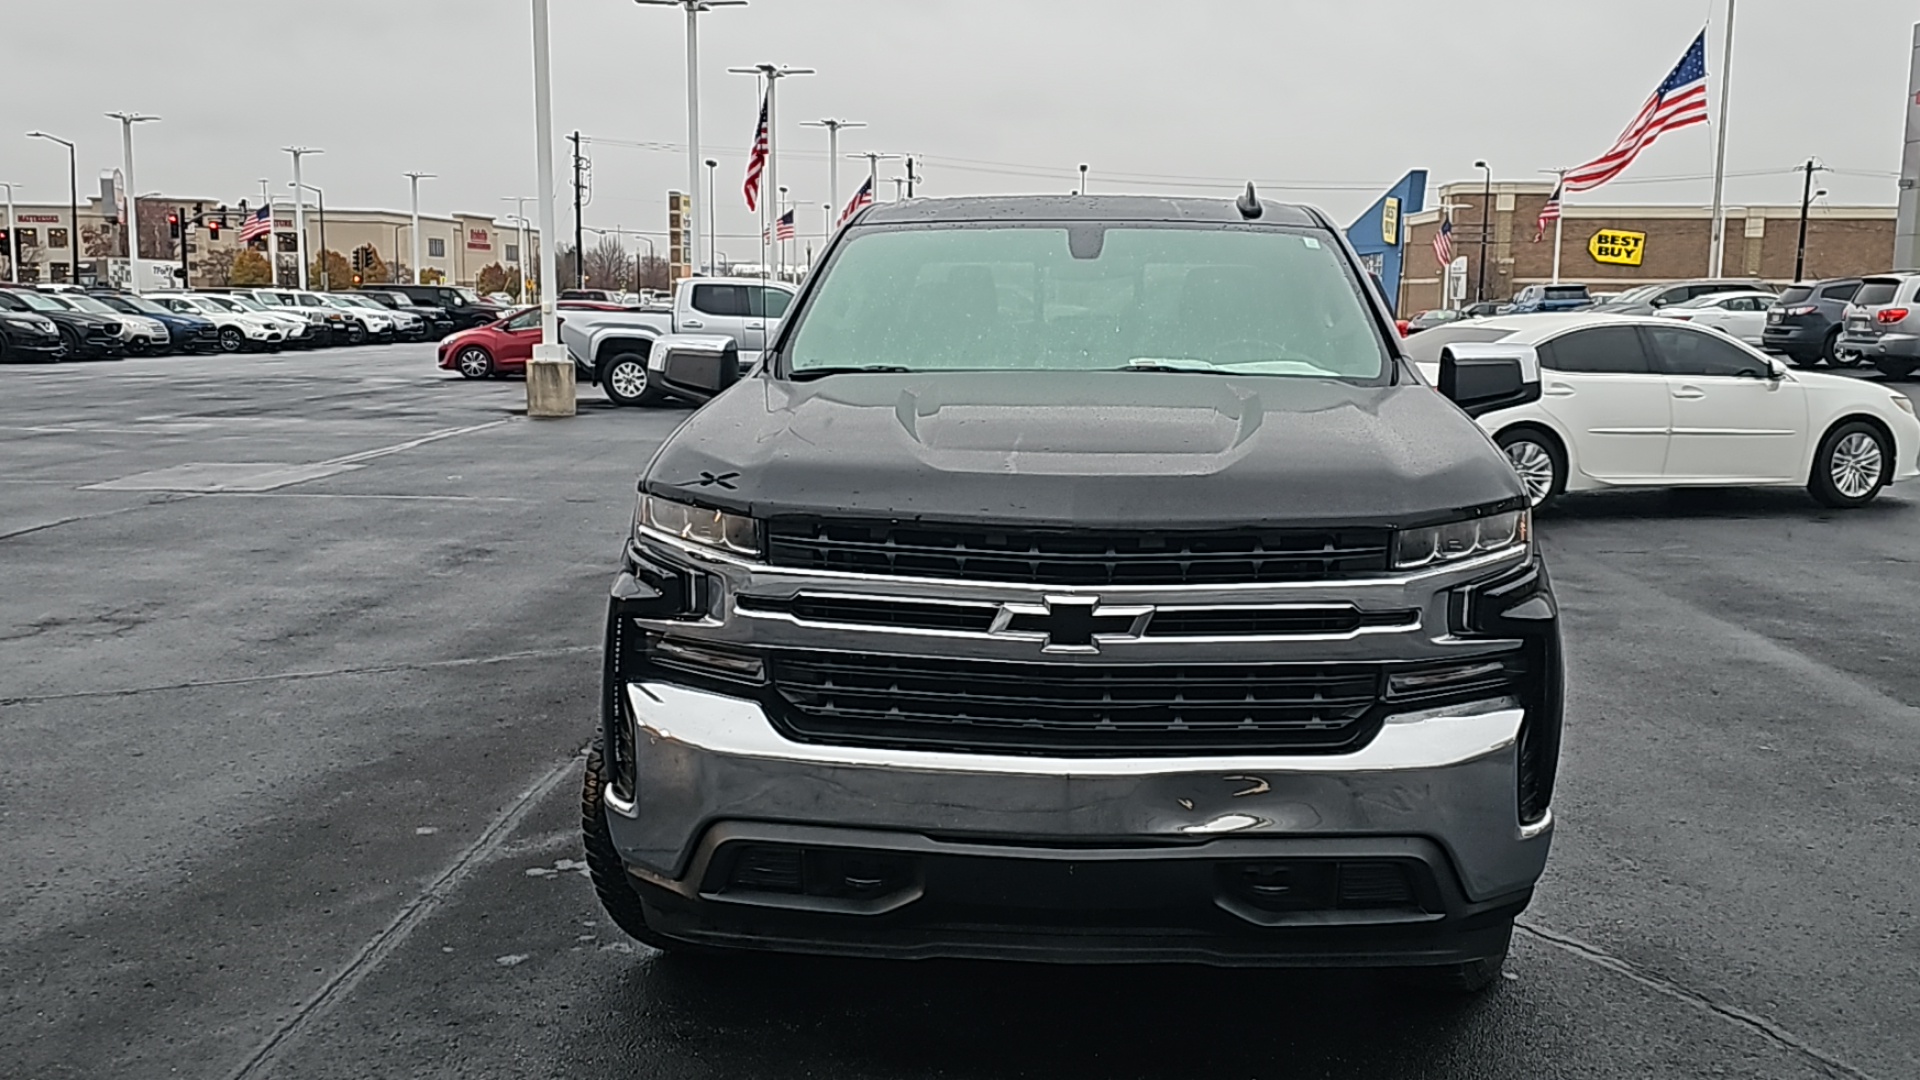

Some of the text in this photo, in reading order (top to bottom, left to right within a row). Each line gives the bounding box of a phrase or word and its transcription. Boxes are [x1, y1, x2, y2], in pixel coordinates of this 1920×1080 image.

[1385, 205, 1396, 219] BEST
[1598, 234, 1642, 247] BEST
[1598, 246, 1636, 258] BUY
